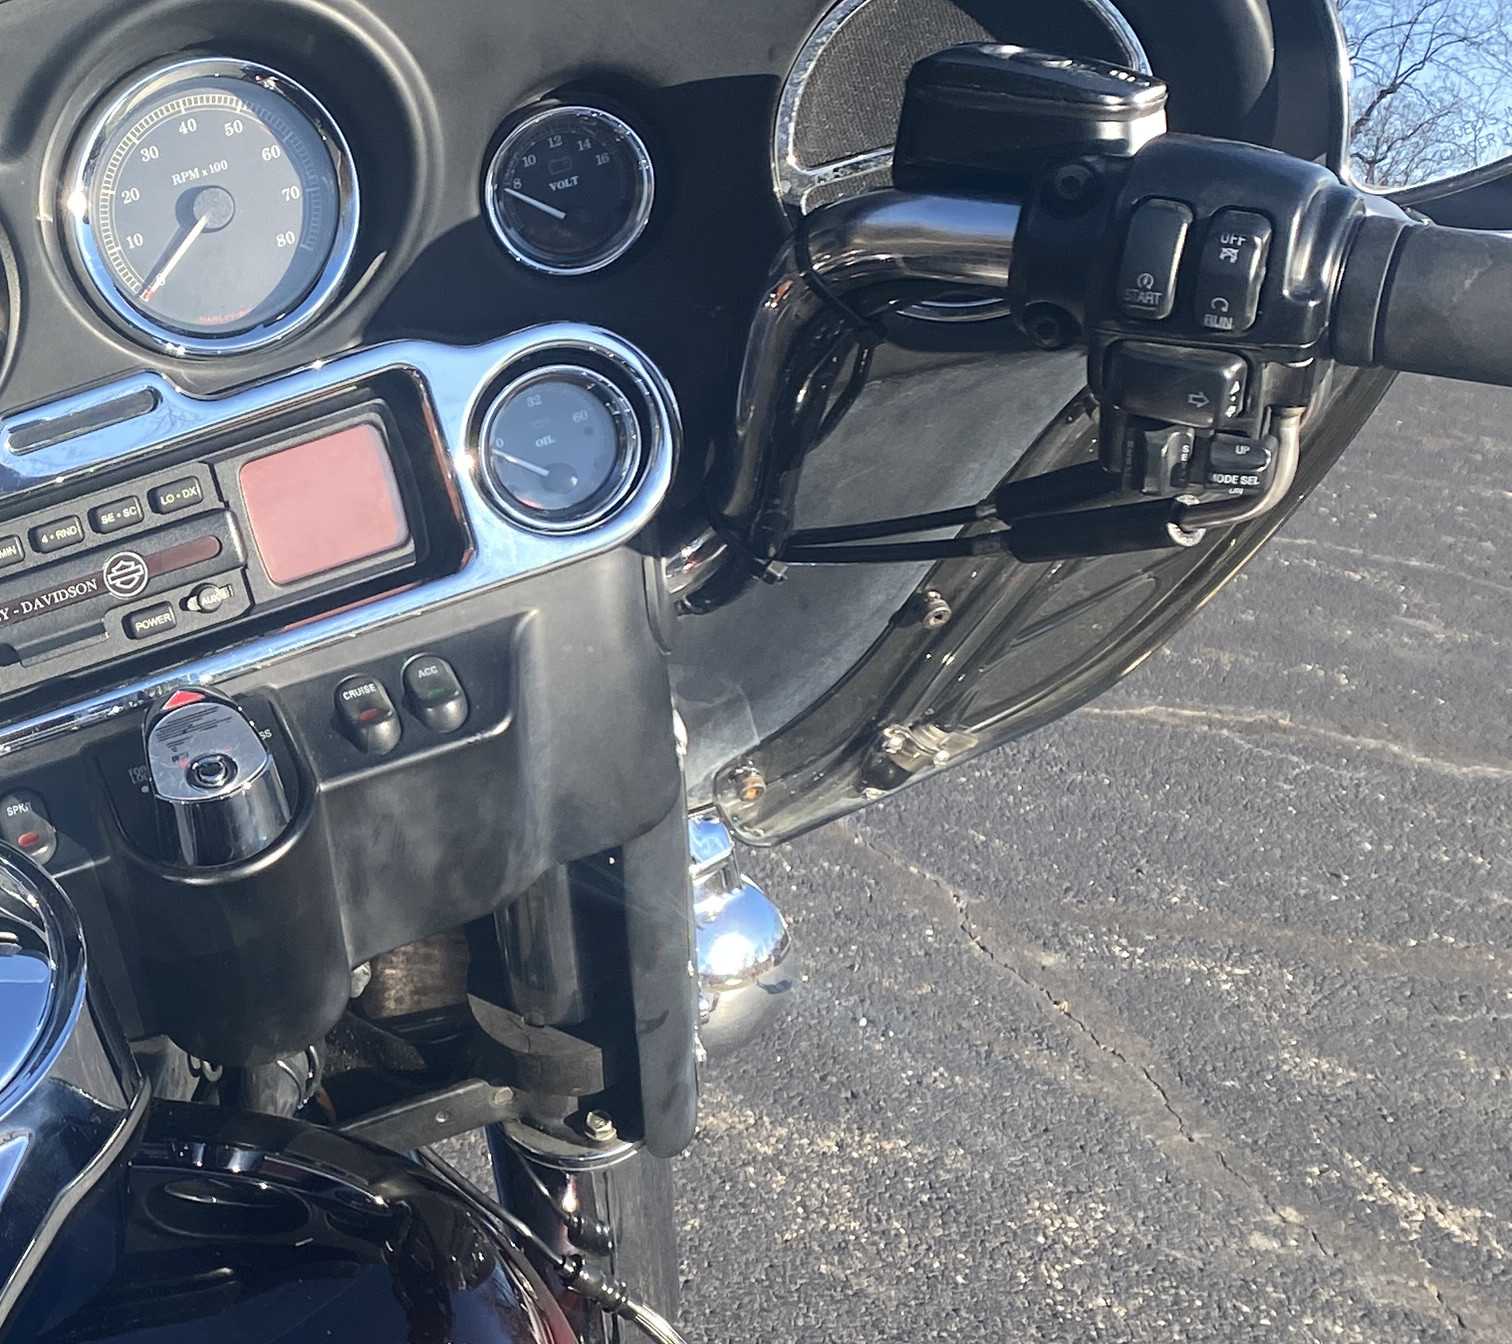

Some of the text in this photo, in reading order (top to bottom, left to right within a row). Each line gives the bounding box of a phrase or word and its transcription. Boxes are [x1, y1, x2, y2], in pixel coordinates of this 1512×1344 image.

[178, 118, 198, 135] 40
[223, 119, 244, 137] 50
[548, 135, 562, 149] 12
[577, 137, 592, 152] 14
[140, 145, 160, 162] 30
[261, 145, 282, 161] 60
[523, 154, 537, 168] 10
[596, 152, 610, 166] 16
[171, 168, 200, 186] RPM
[208, 160, 228, 175] 100
[513, 178, 522, 190] 8
[549, 175, 579, 192] VOLT
[121, 188, 141, 205] 20
[282, 186, 301, 202] 70
[127, 233, 144, 249] 10
[276, 231, 296, 248] 80
[1125, 289, 1162, 305] START
[1203, 314, 1233, 330] RUN
[534, 434, 556, 448] OIL
[1235, 445, 1250, 455] UP
[1240, 476, 1260, 485] SEL
[135, 613, 172, 632] POWER
[418, 665, 438, 679] ACC
[342, 683, 377, 701] CRUISE
